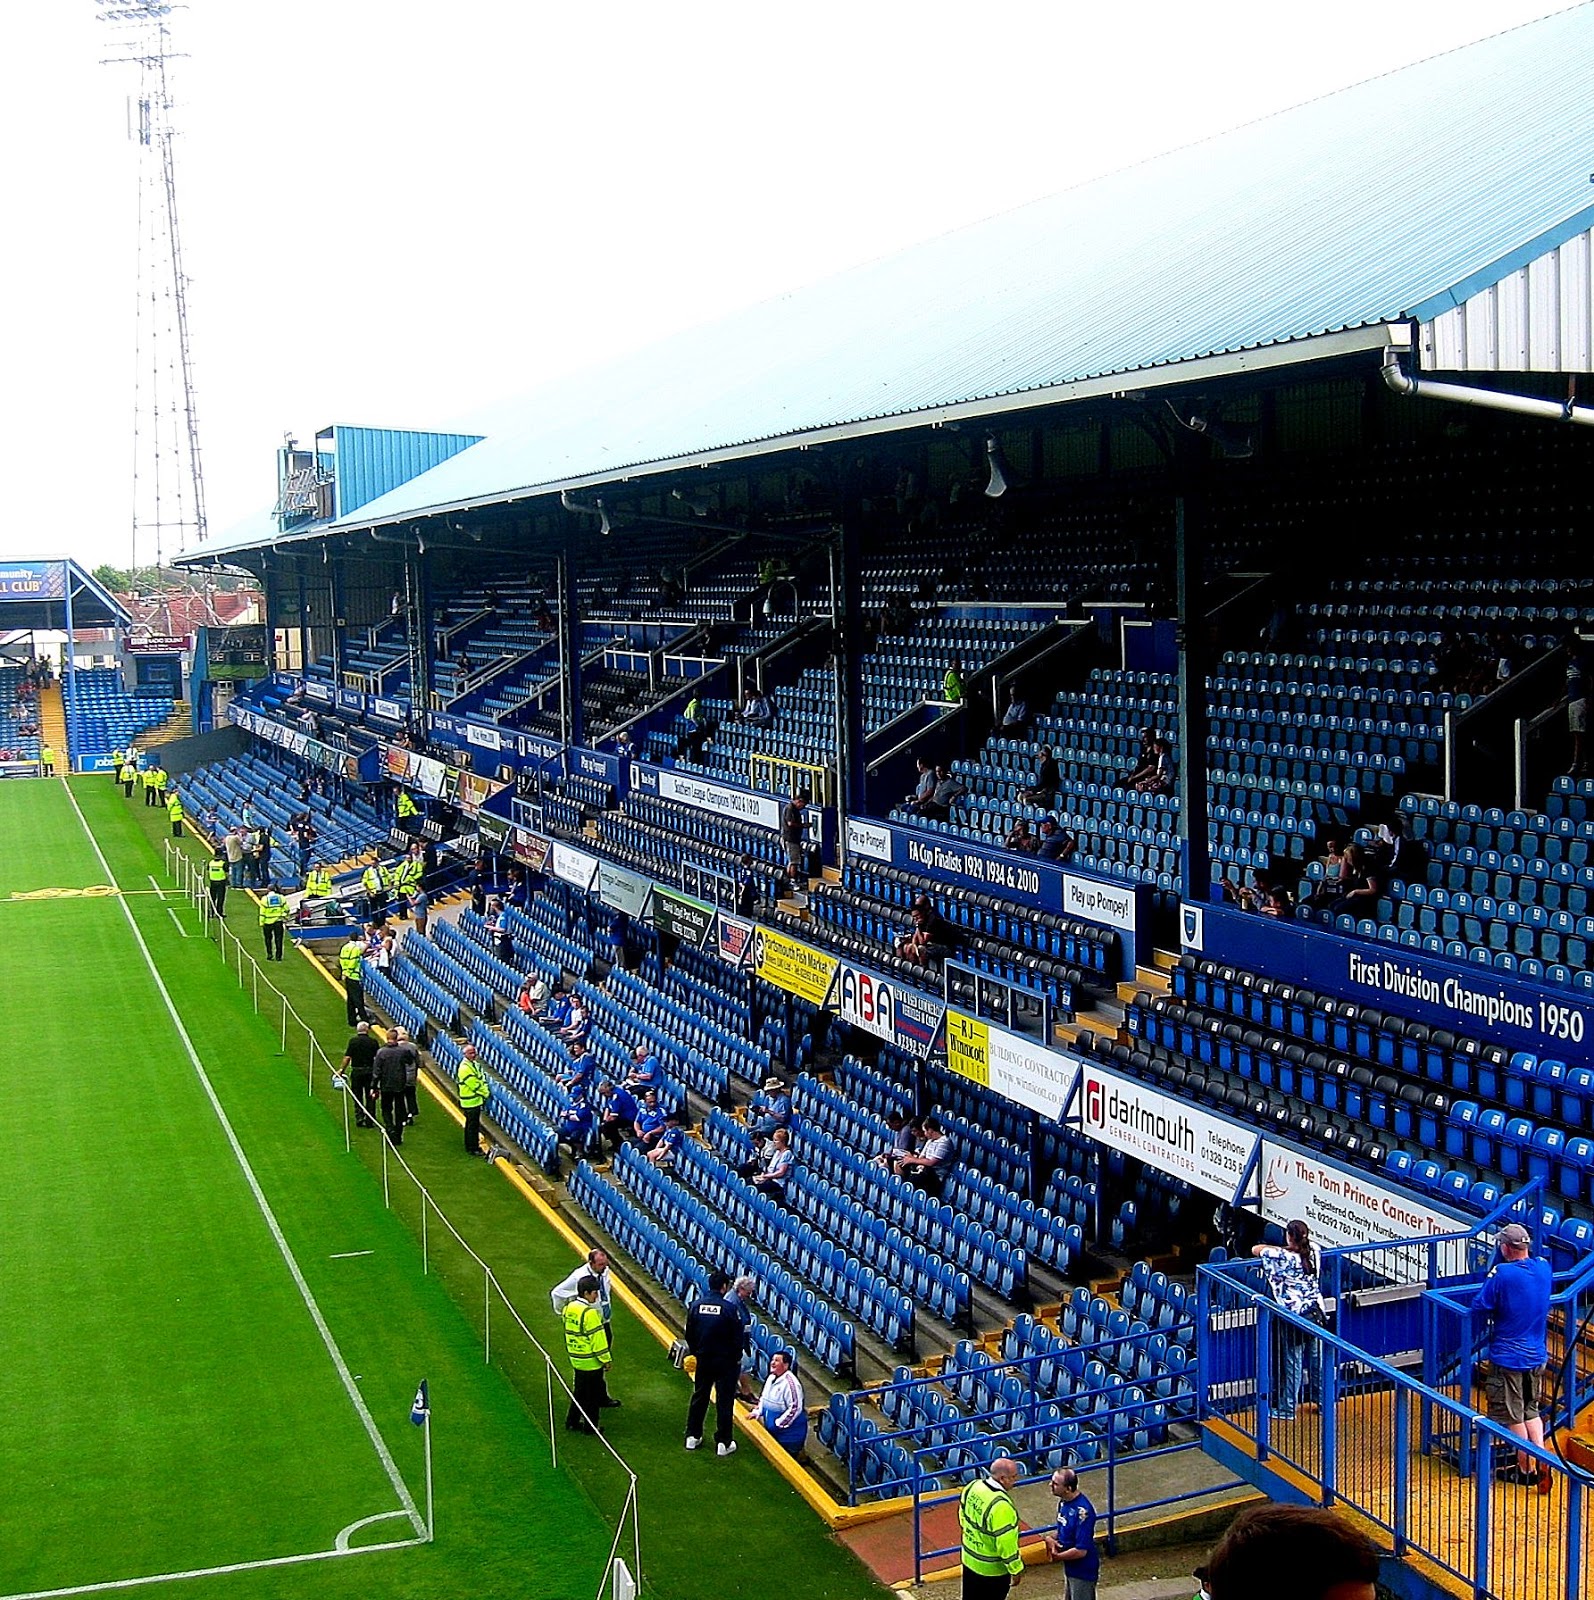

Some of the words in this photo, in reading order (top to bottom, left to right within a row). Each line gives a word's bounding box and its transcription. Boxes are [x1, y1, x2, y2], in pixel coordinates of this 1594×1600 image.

[909, 840, 919, 862] FA
[920, 843, 934, 870] Cup
[934, 847, 962, 873] Finalists
[964, 855, 984, 882] 1929,
[986, 859, 1005, 884] 1934
[1006, 867, 1016, 889] &
[1017, 867, 1039, 894] 2010
[1071, 885, 1085, 908] Play
[1086, 892, 1095, 911] up
[1096, 892, 1129, 919] Pompey!
[765, 933, 796, 960] Portsmouth
[796, 947, 807, 965] Fish
[808, 952, 828, 975] Market
[843, 968, 893, 1032] ABA
[1350, 953, 1381, 988] First
[1384, 961, 1440, 1005] Division
[1443, 977, 1533, 1029] Champions
[1539, 1001, 1584, 1042] 1950
[950, 1053, 986, 1082] LIMITED
[989, 1042, 1023, 1068] BUILDING
[1024, 1057, 1073, 1088] CONTRACTO
[1109, 1089, 1195, 1154] dartmouth
[1109, 1125, 1142, 1150] GENERAL
[1142, 1140, 1195, 1173] CONTRACTORS
[1201, 1147, 1222, 1167] 01329
[1223, 1155, 1238, 1172] 235
[1208, 1130, 1246, 1158] Telephone
[1295, 1161, 1315, 1184] The
[1318, 1170, 1341, 1195] Tom
[1343, 1181, 1379, 1212] Prince
[1381, 1198, 1424, 1231] Cancer
[1313, 1194, 1347, 1219] Registered
[1348, 1209, 1372, 1232] Charity
[1317, 1211, 1338, 1232] 02392
[1352, 1227, 1365, 1242] 741
[701, 1305, 719, 1314] FILA
